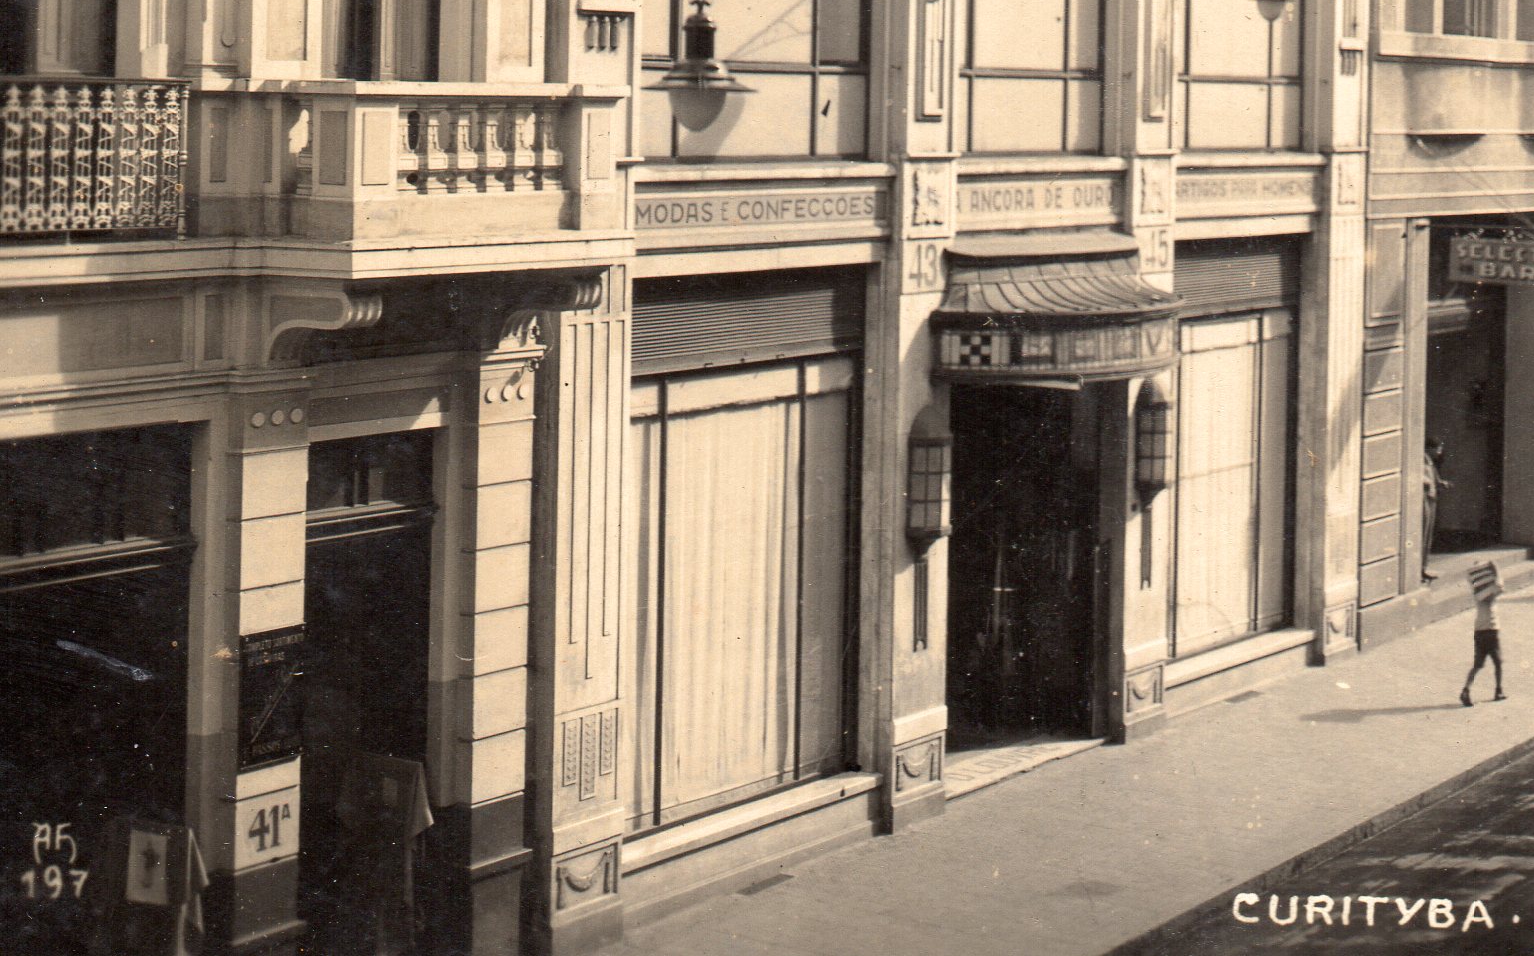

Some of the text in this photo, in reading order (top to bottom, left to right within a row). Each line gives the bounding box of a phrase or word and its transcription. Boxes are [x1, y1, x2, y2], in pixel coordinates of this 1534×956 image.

[635, 202, 713, 226] MODAS
[720, 201, 729, 221] E
[970, 187, 1034, 212] ANCORA
[1044, 186, 1063, 209] DE
[1145, 229, 1168, 268] 45
[909, 244, 937, 287] 43
